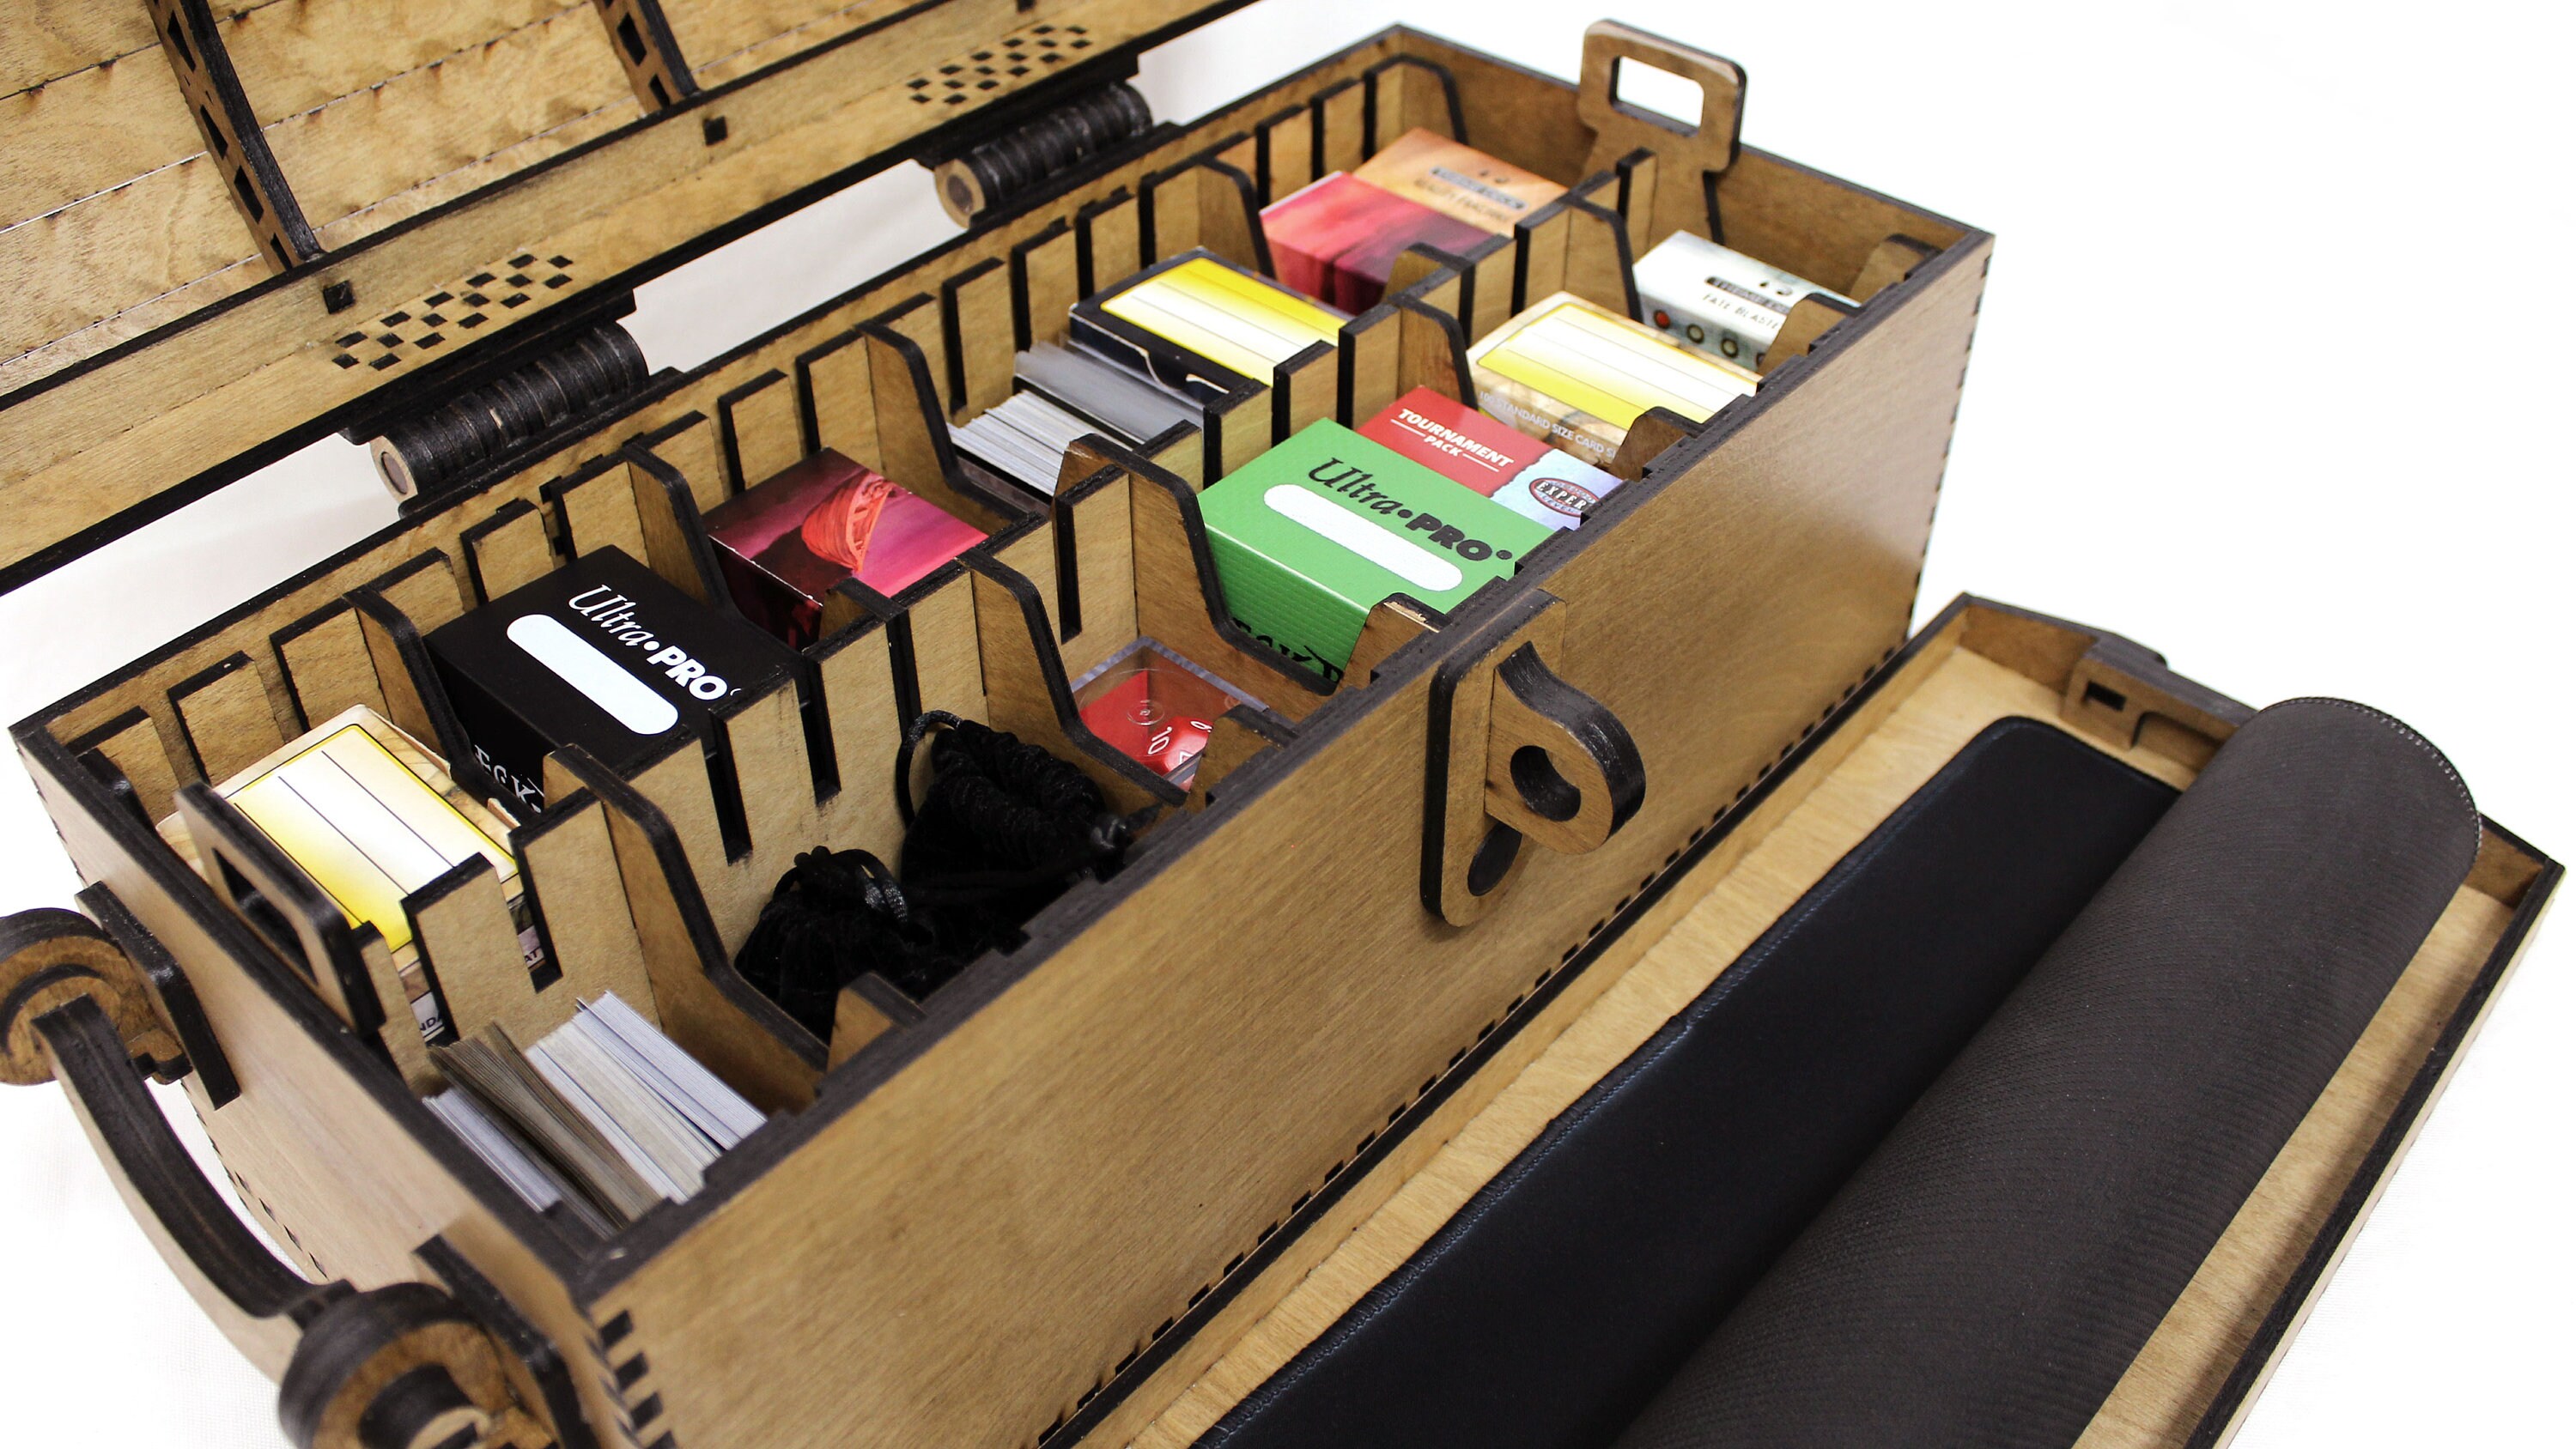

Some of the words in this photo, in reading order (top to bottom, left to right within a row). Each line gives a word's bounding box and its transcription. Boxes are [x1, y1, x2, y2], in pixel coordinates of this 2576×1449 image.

[1398, 409, 1514, 466] TOURNAMENT
[1424, 435, 1461, 457] PACK
[1496, 399, 1551, 429] STANDARD
[1552, 423, 1574, 440] SIZE
[1576, 434, 1605, 454] CARD
